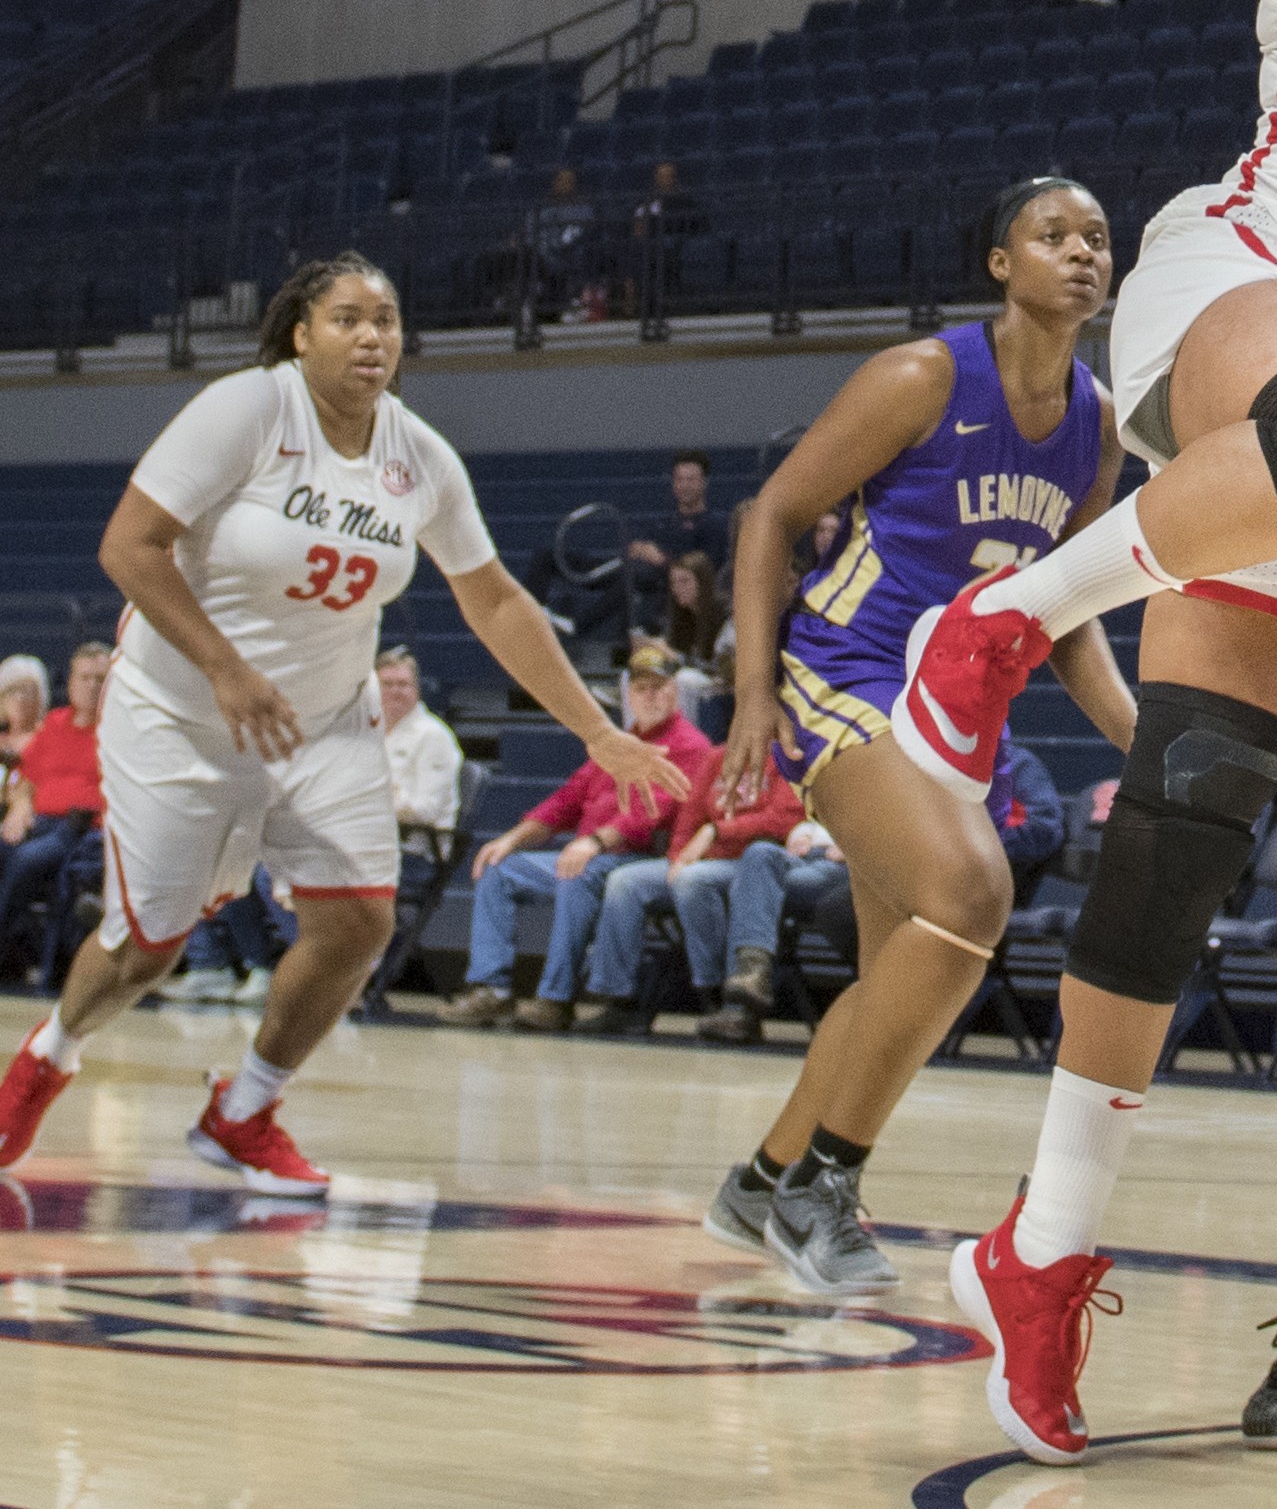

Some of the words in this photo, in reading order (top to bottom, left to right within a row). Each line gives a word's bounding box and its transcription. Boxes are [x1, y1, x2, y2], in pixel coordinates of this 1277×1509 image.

[283, 485, 331, 528] Ole
[339, 498, 403, 547] Miss
[957, 473, 1073, 541] LEMOYNE
[284, 543, 379, 611] 33
